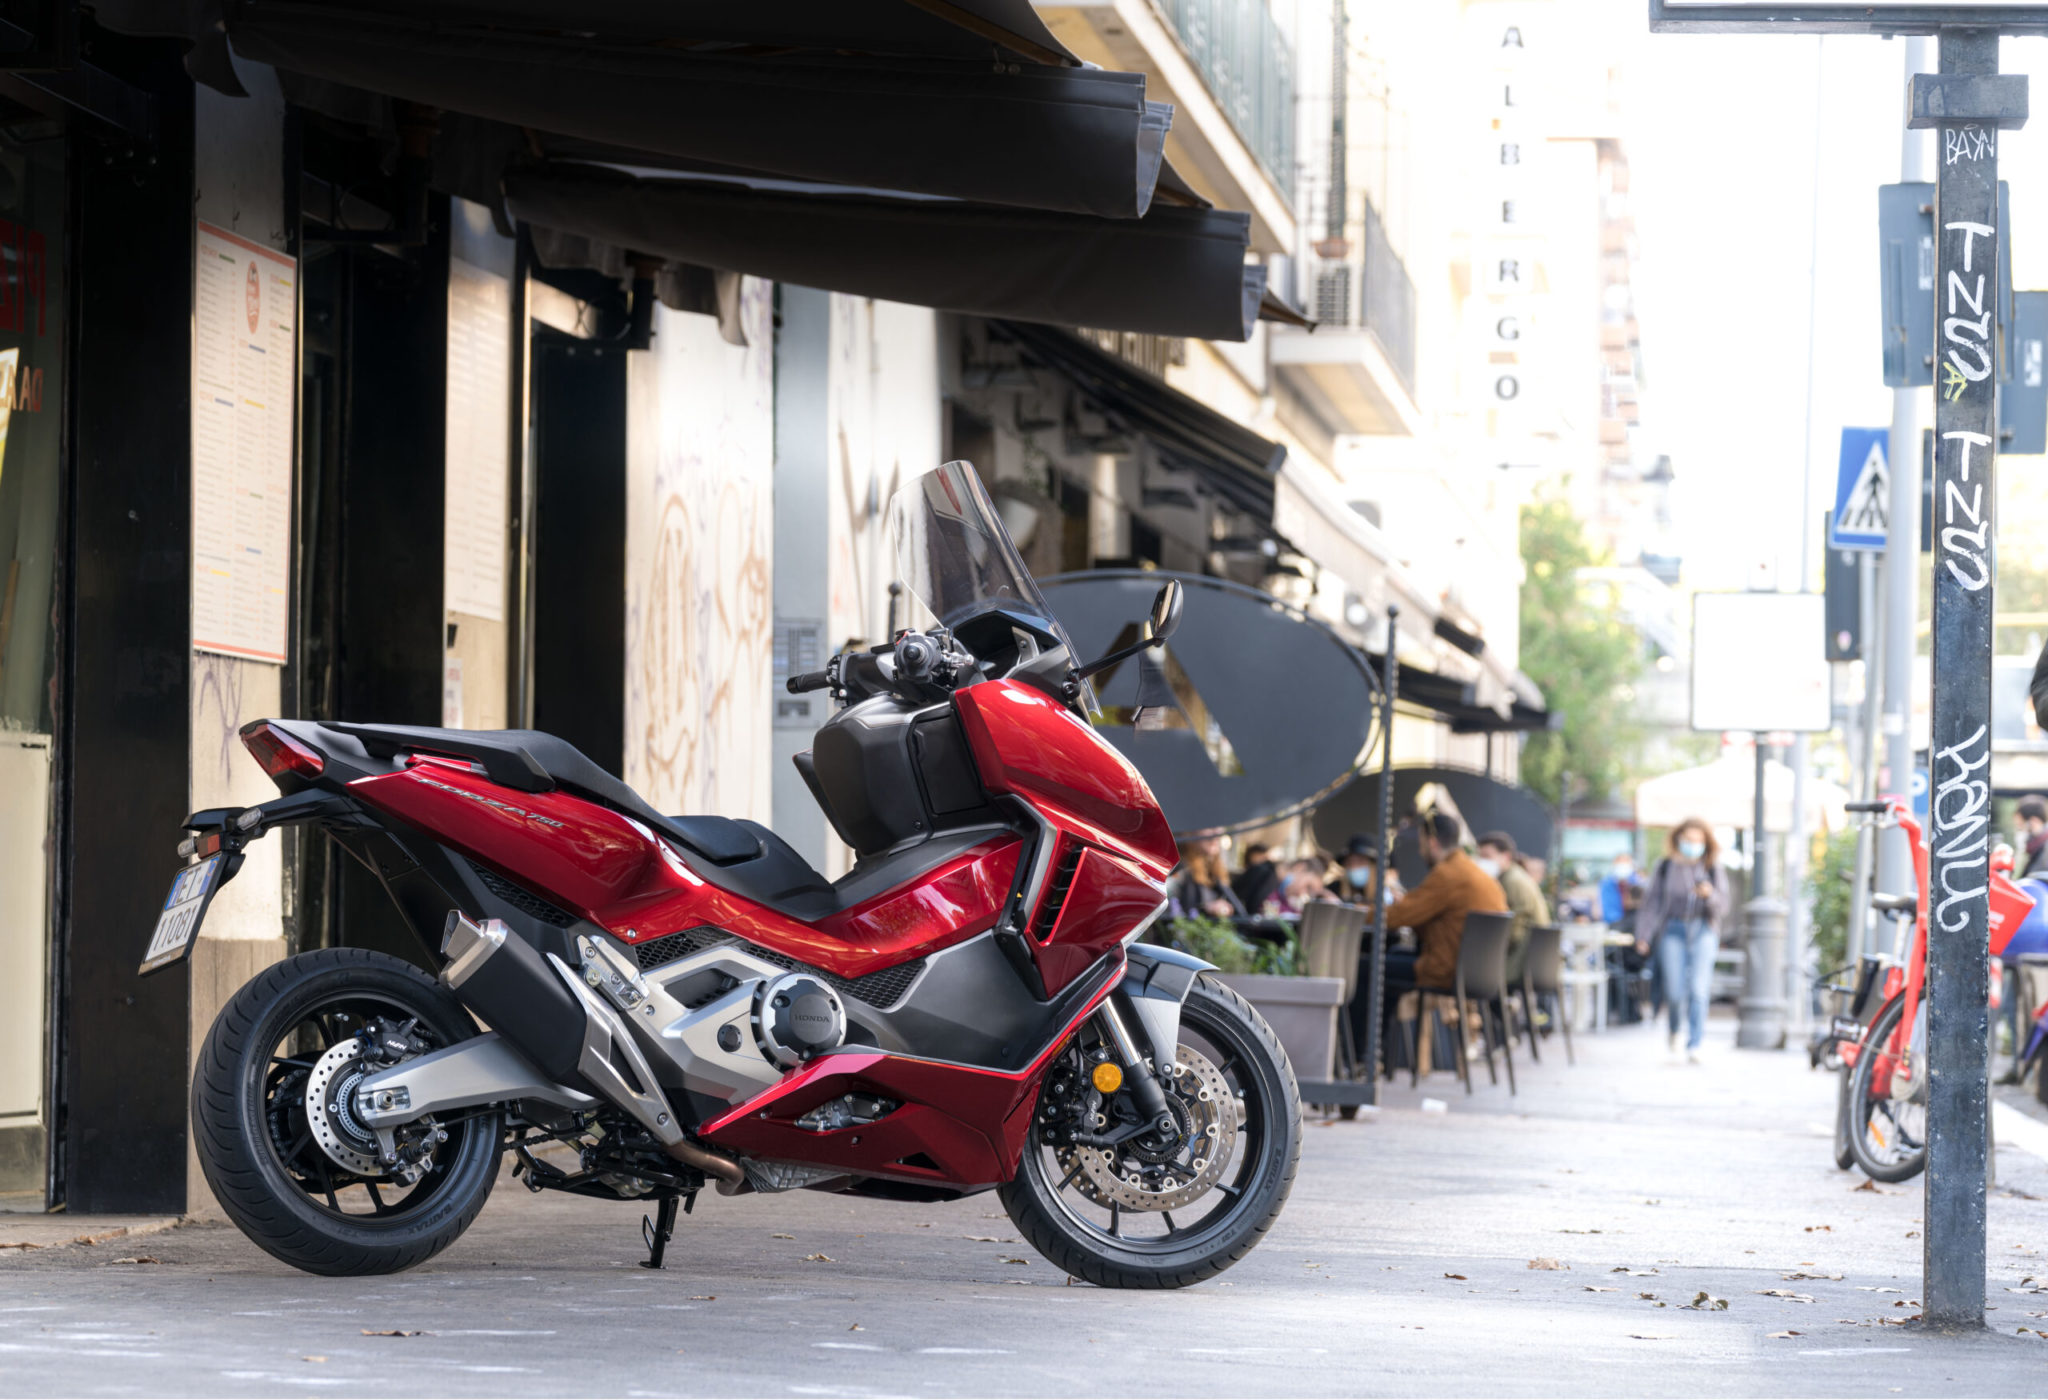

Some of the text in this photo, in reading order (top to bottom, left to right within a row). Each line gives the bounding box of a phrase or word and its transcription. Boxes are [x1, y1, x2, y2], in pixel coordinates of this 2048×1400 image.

[1495, 26, 1524, 401] ALBERGO
[526, 812, 565, 828] 750
[794, 1014, 830, 1023] HONDA
